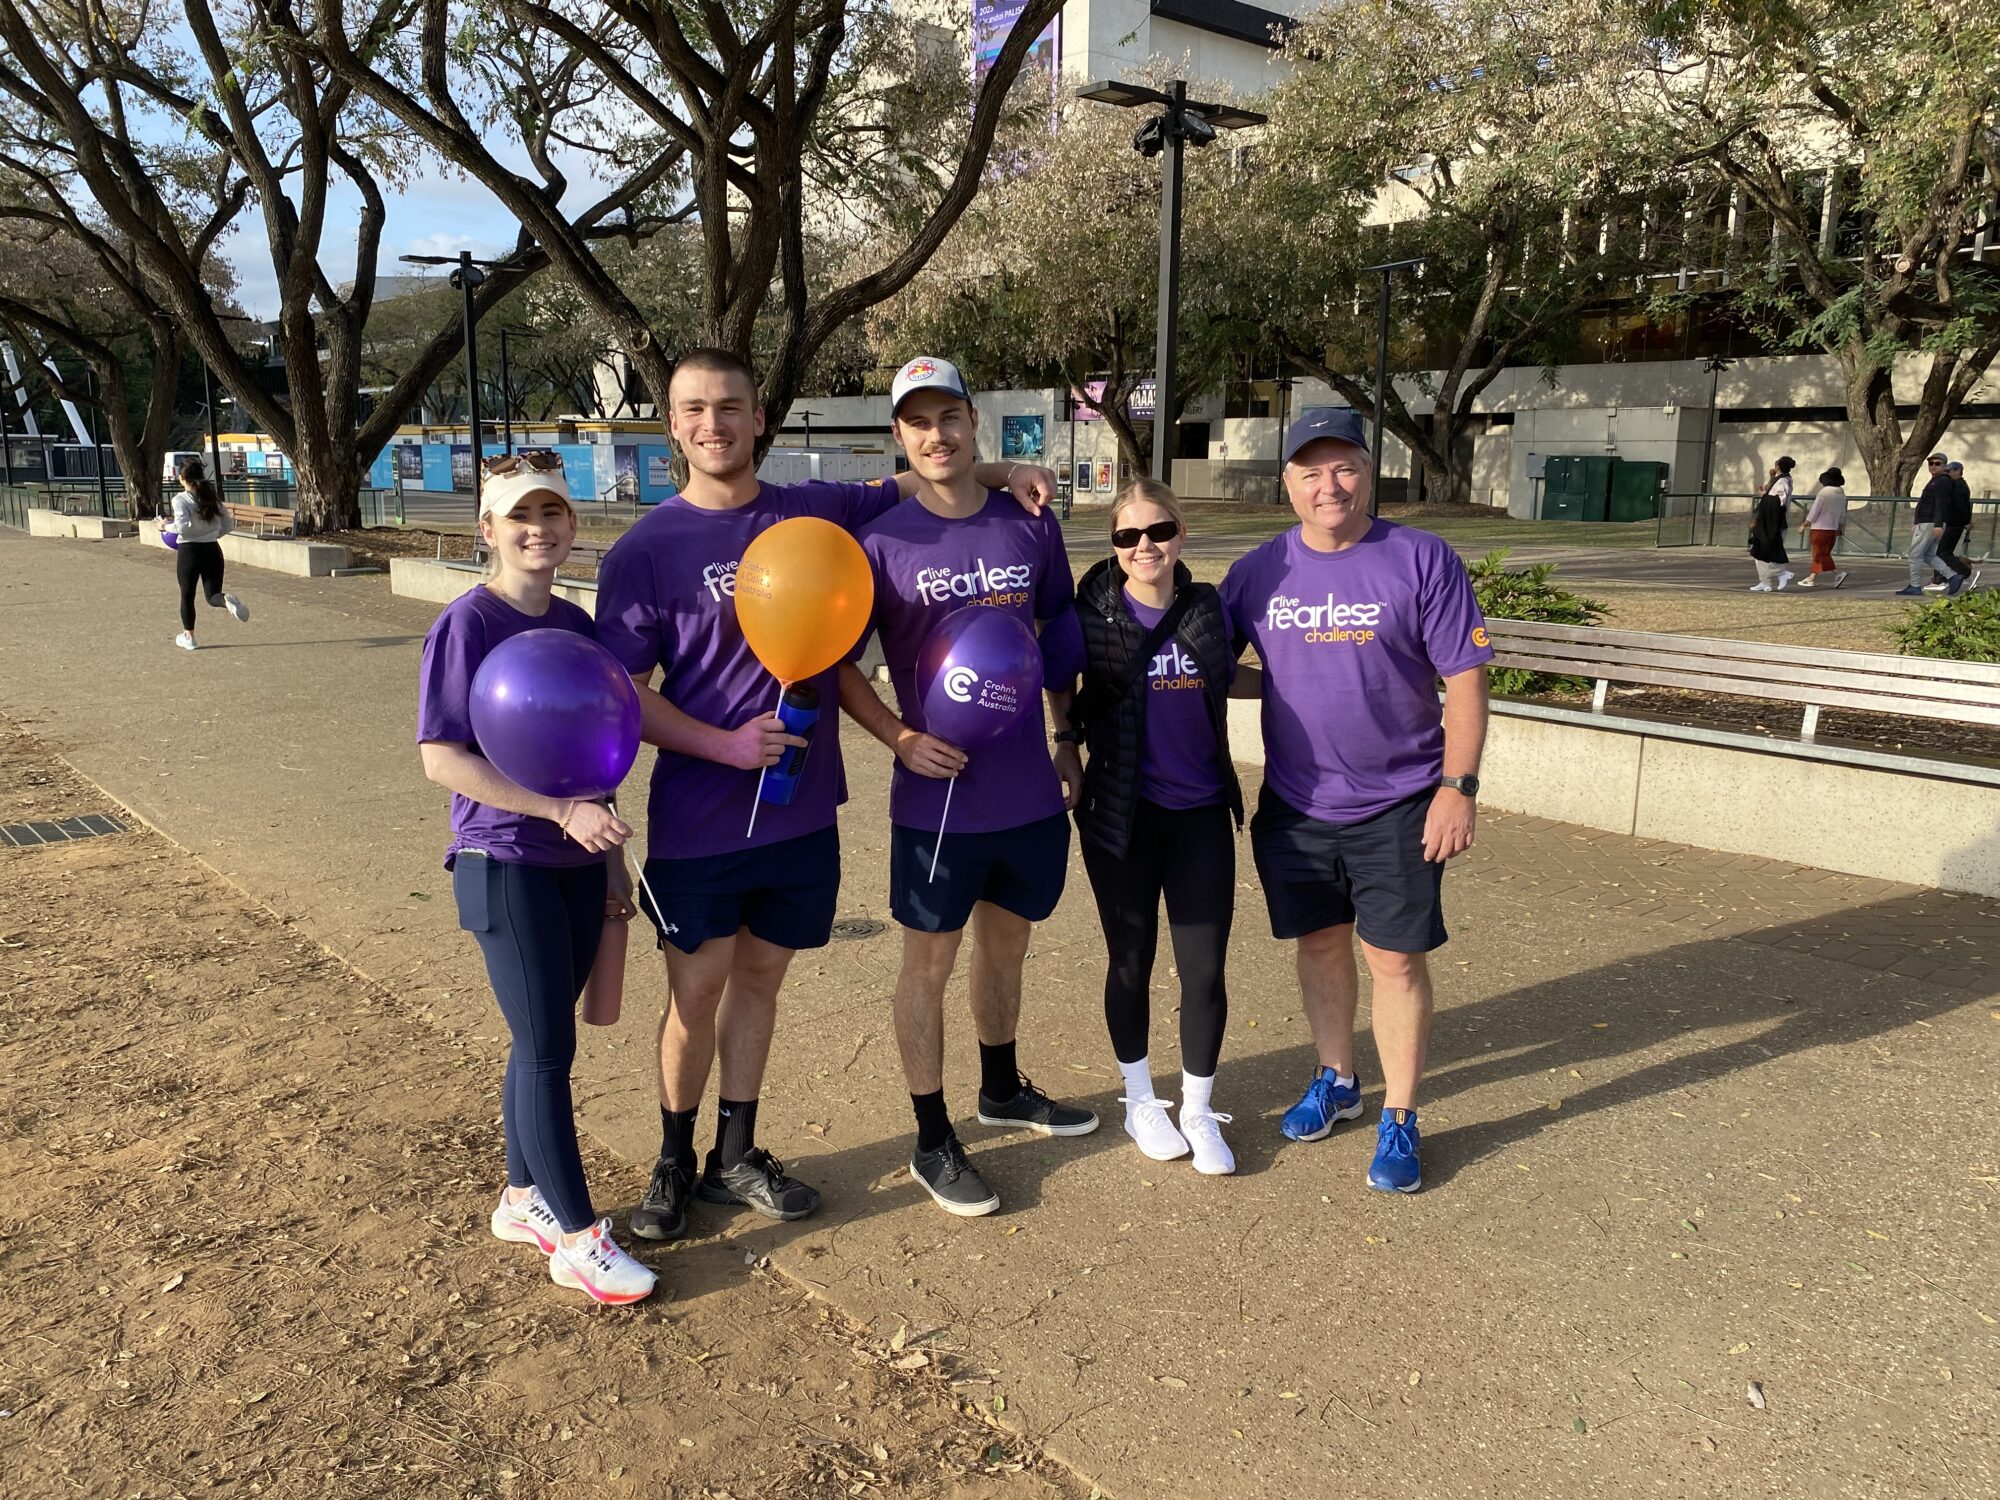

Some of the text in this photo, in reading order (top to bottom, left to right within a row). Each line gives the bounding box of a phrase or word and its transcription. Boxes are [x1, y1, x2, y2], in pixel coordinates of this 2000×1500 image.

[979, 6, 994, 16] 2023
[1004, 5, 1025, 18] PALISA
[712, 560, 738, 575] live
[744, 560, 770, 576] Crohn's
[927, 567, 951, 580] live
[916, 558, 1030, 606] fearless
[738, 583, 772, 600] Australia
[1279, 594, 1299, 608] live
[1267, 593, 1380, 631] fearless
[1305, 626, 1375, 645] challenge
[1147, 643, 1199, 677] arle
[984, 680, 1016, 695] Crohn's
[1152, 674, 1206, 690] challen
[980, 688, 1017, 703] & Colitis
[977, 698, 1017, 712] Australia
